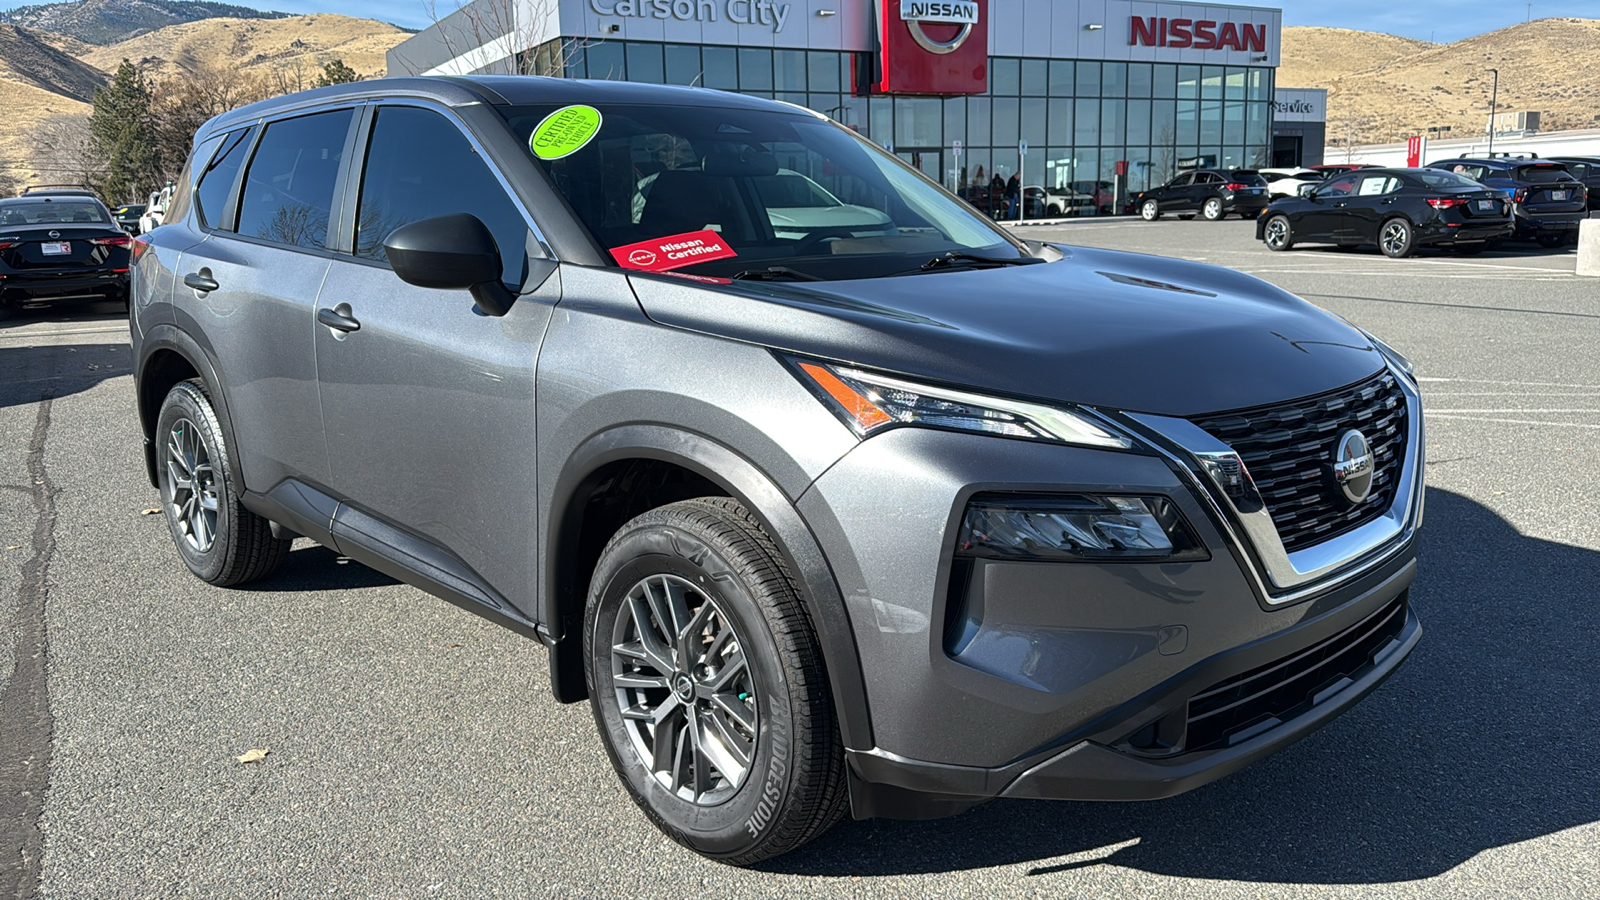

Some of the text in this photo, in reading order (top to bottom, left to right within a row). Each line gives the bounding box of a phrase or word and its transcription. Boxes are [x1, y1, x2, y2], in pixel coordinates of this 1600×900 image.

[591, 0, 791, 33] Carson City
[911, 2, 973, 19] NISSAN
[1128, 15, 1266, 52] NISSAN
[1273, 99, 1314, 113] Service
[535, 109, 578, 148] CERTIFIED
[550, 115, 586, 148] PRE-OWNED
[565, 121, 594, 145] VEHICLE
[660, 239, 704, 252] Nissan
[667, 243, 722, 260] Certified
[628, 253, 657, 263] NISSAN
[744, 693, 789, 839] BRIDGESTONE
